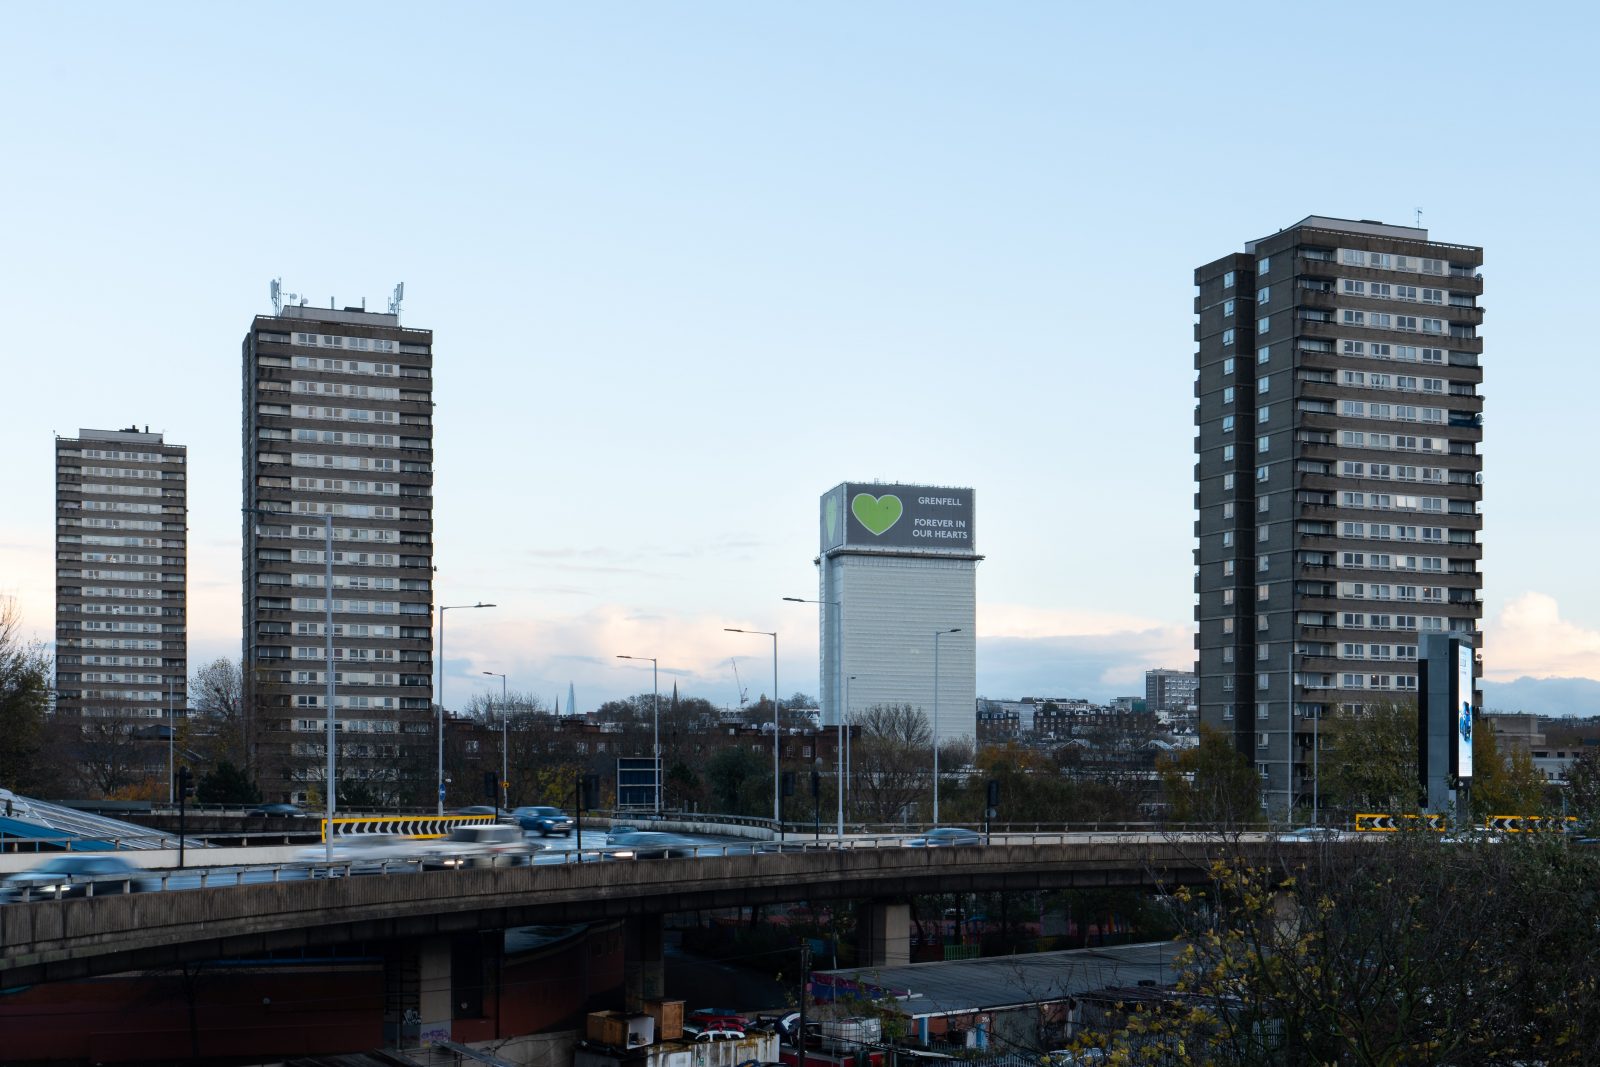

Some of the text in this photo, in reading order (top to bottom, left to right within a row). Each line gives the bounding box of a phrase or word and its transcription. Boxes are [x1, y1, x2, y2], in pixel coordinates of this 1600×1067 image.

[918, 496, 962, 506] GRENFELL
[914, 518, 966, 528] FOREVER IN
[912, 529, 968, 539] OUR HEARTS
